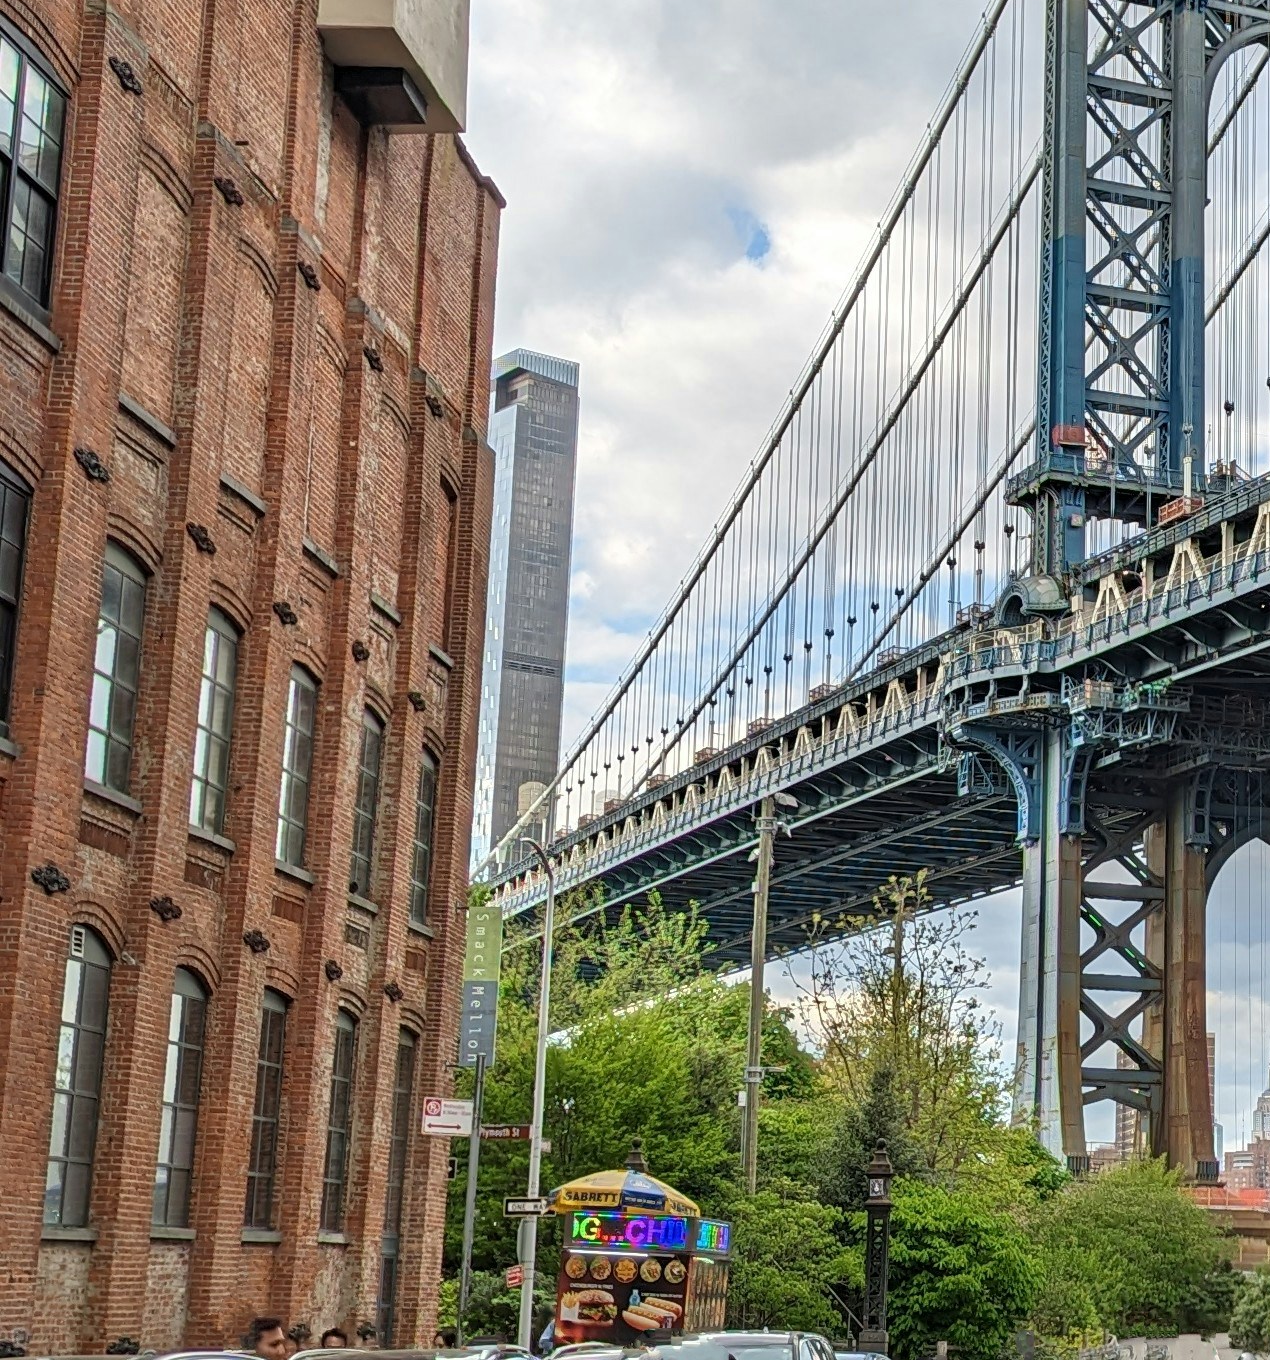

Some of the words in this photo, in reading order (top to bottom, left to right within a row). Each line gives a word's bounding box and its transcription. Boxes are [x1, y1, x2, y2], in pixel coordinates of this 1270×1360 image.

[472, 913, 490, 977] Smack
[467, 985, 485, 1063] Mellon
[511, 1127, 521, 1138] St
[564, 1191, 619, 1203] SABRETT
[511, 1203, 526, 1211] ONE
